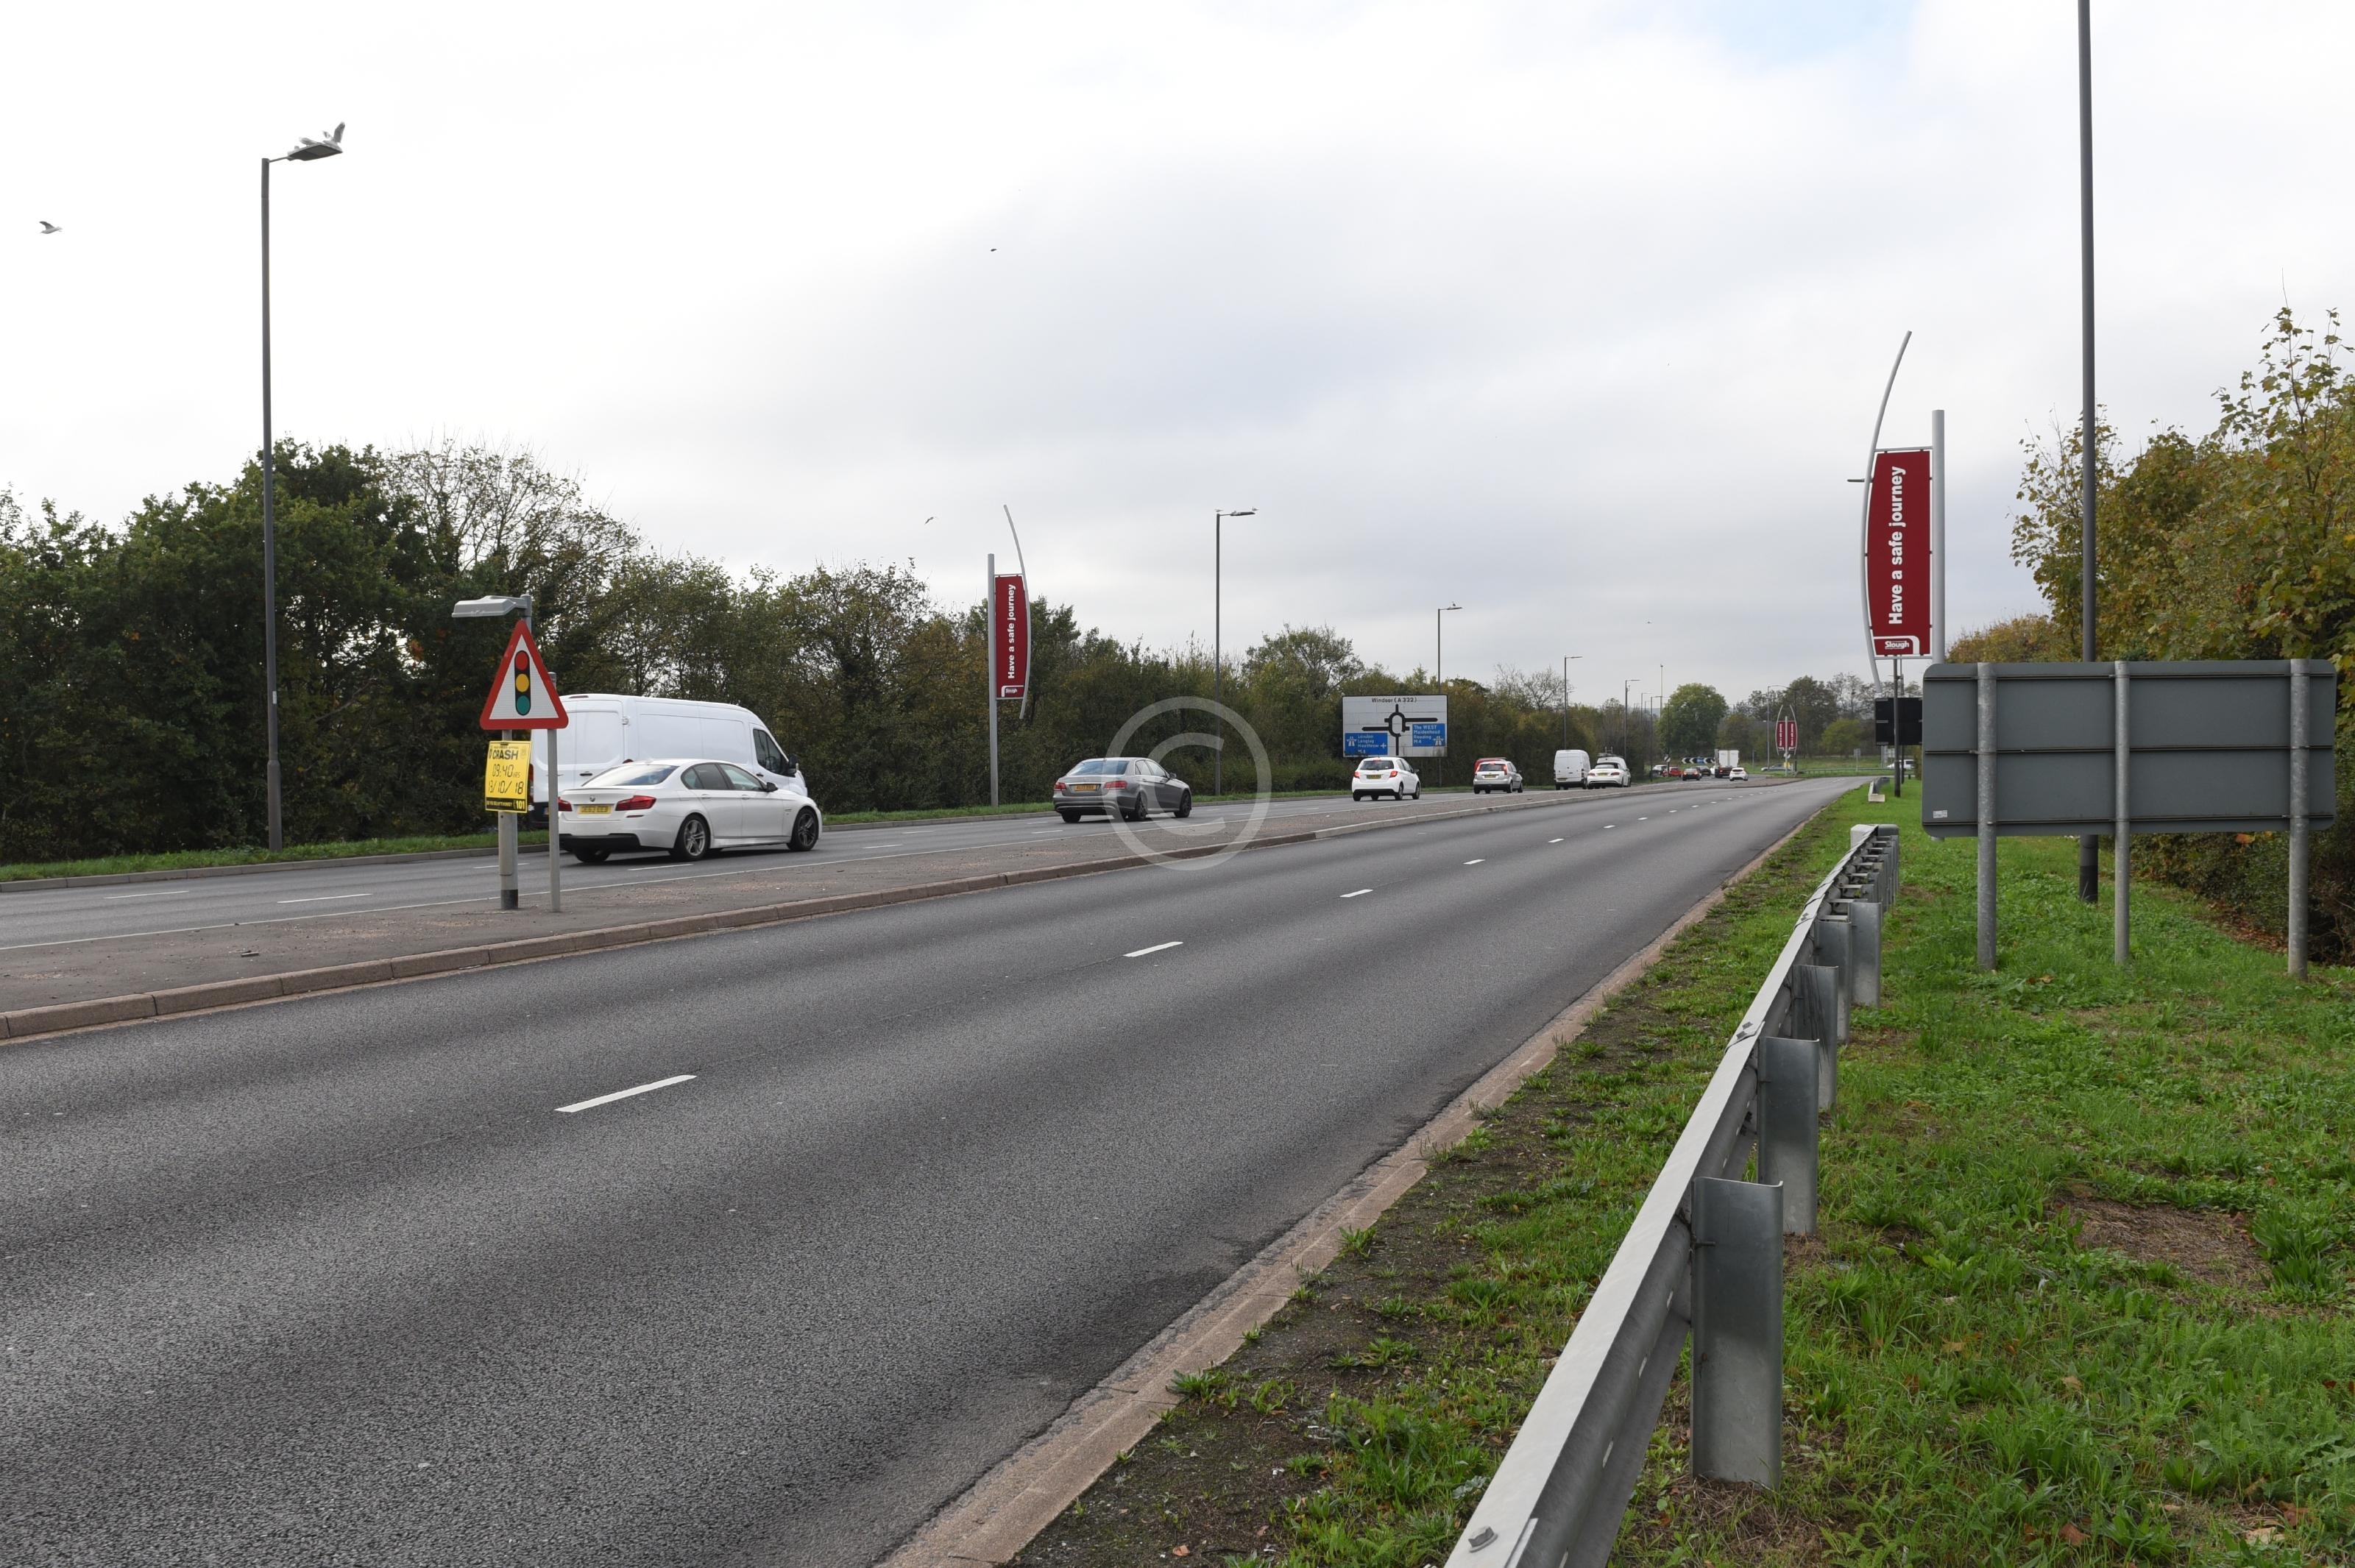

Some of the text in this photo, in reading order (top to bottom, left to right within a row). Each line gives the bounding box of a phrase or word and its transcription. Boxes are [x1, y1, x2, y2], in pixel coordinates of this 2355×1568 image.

[1888, 466, 1906, 624] Have a safe journey
[1007, 584, 1016, 621] journey
[1885, 640, 1910, 650] Slough
[492, 750, 519, 760] CRASH
[492, 764, 514, 778] 09:40
[516, 800, 525, 809] 101
